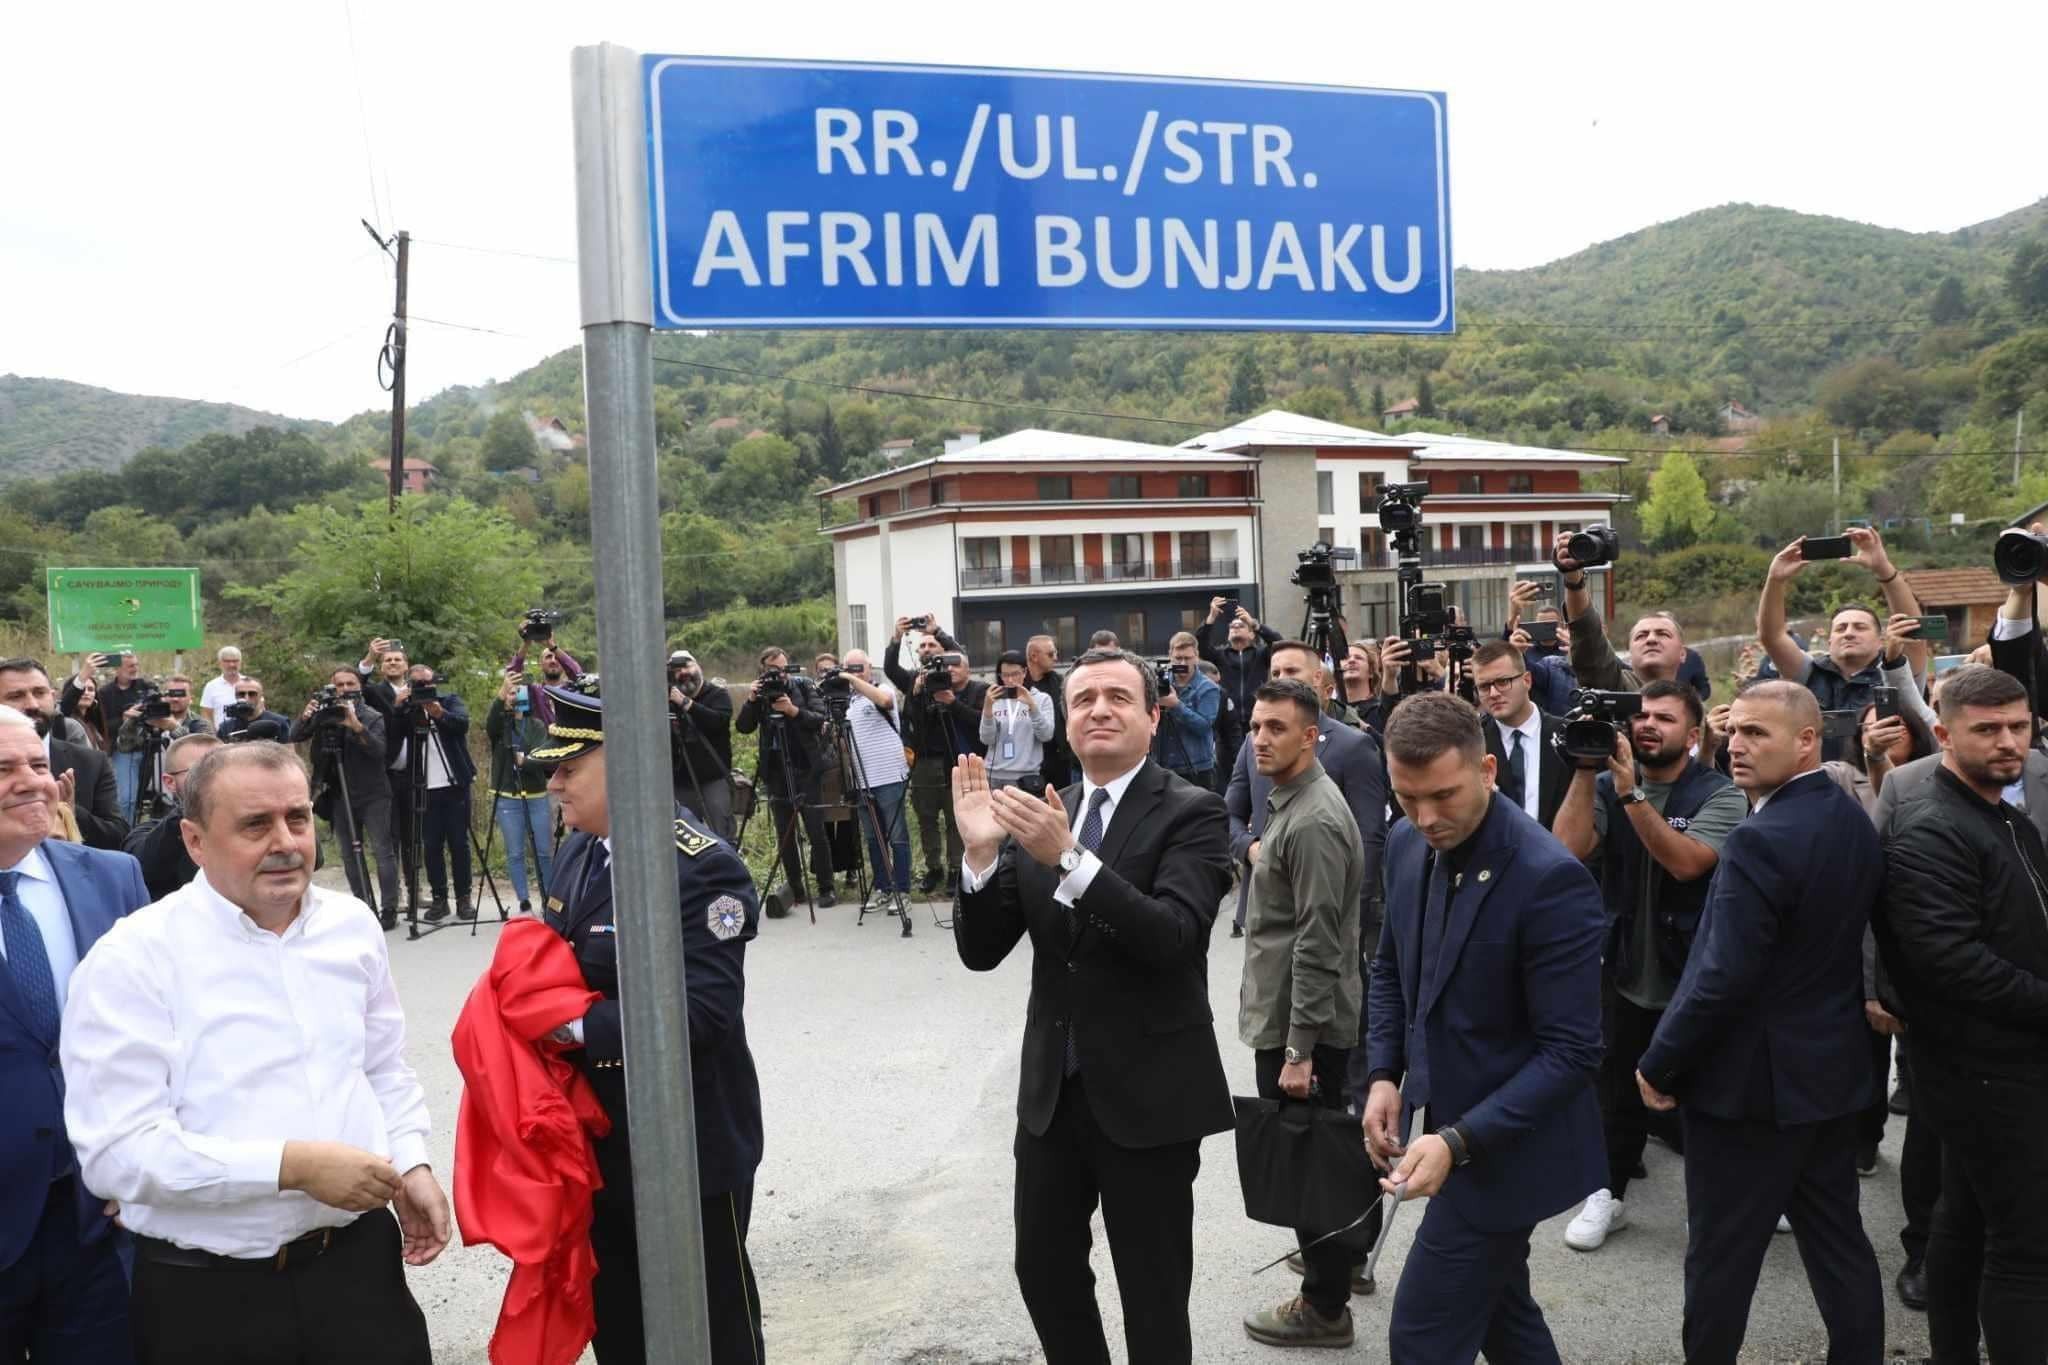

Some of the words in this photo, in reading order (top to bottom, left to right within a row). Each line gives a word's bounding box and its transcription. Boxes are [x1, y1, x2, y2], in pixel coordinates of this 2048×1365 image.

[814, 103, 1318, 196] RR./UL./STR.
[692, 210, 999, 287] AFRIM
[1035, 215, 1421, 294] BUNJAKU
